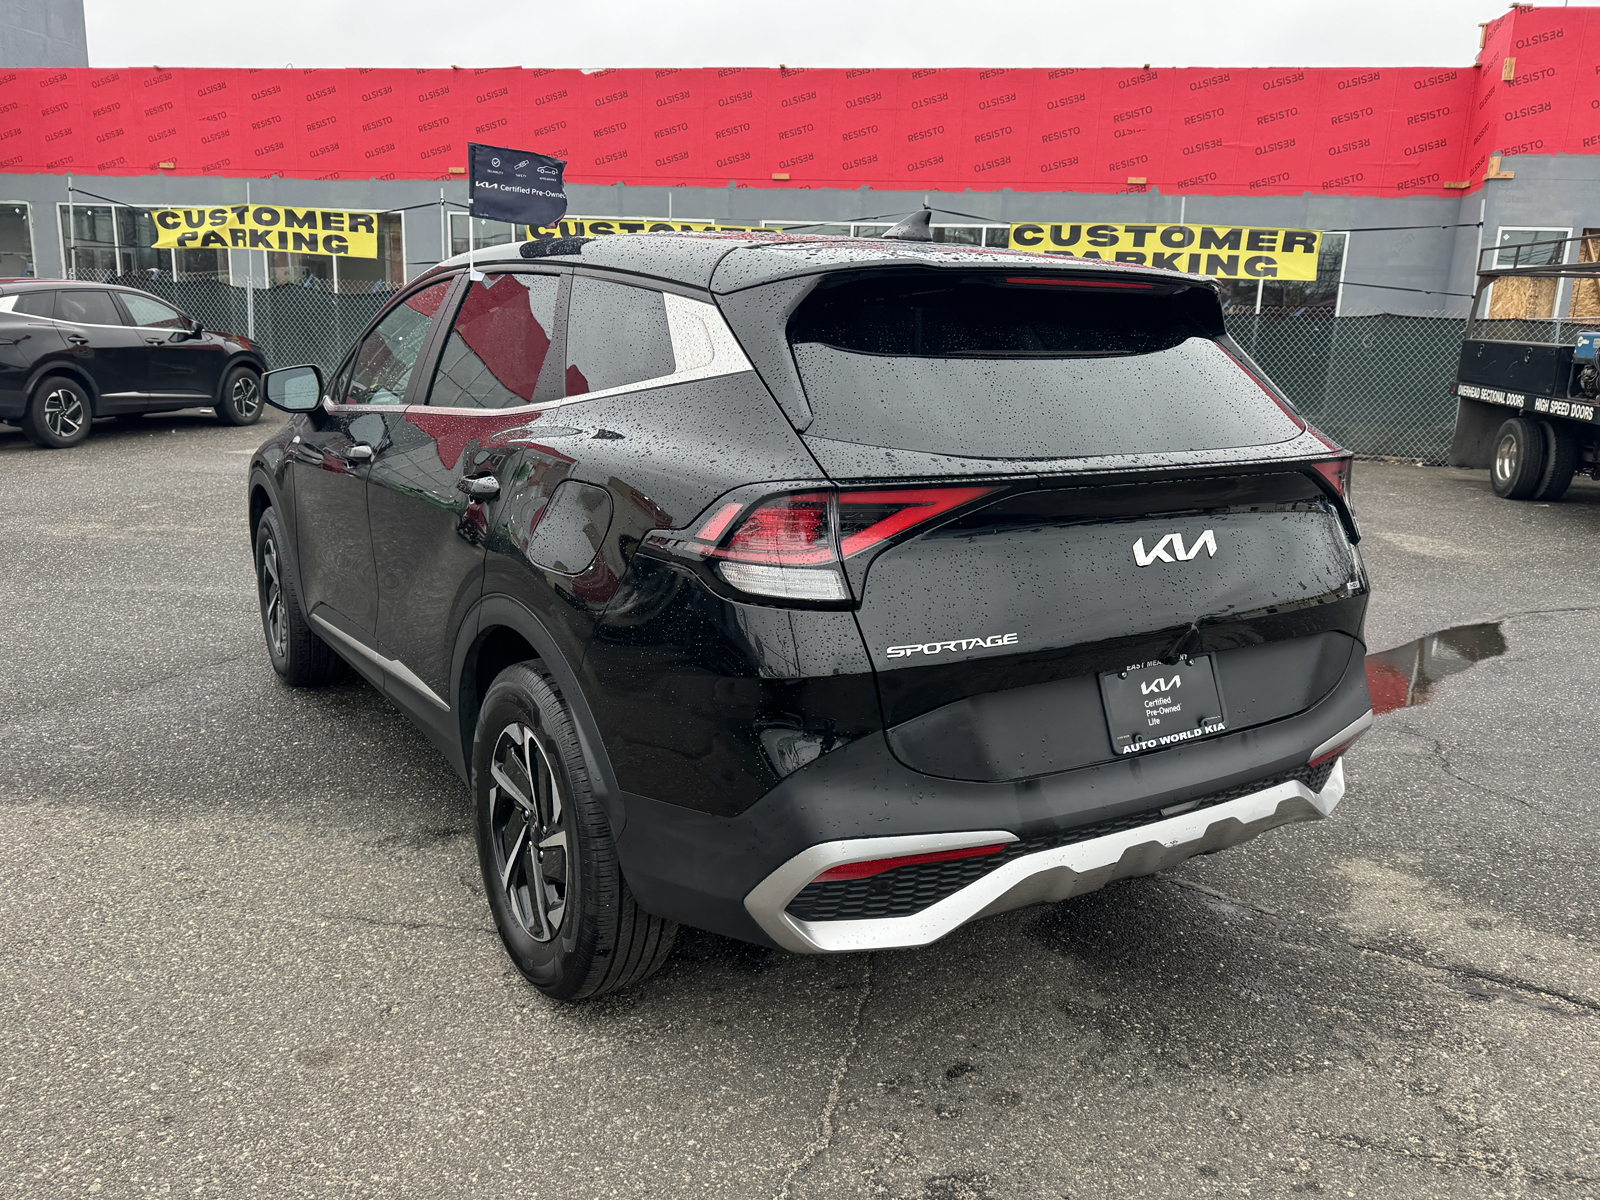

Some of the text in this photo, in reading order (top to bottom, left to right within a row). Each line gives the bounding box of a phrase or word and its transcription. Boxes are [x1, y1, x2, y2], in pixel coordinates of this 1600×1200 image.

[1516, 28, 1564, 49] RESISTO
[40, 74, 67, 87] RESISTO
[92, 73, 119, 88] RESISTO
[144, 73, 172, 87] RESISTO
[1118, 71, 1159, 89] RESISTO
[1189, 73, 1231, 91] RESISTO
[1262, 73, 1305, 91] RESISTO
[1338, 72, 1380, 90] RESISTO
[1413, 71, 1457, 90] RESISTO
[198, 82, 226, 97] RESISTO
[252, 86, 281, 100] RESISTO
[306, 86, 336, 102] RESISTO
[362, 86, 392, 102] RESISTO
[419, 86, 450, 102] RESISTO
[476, 88, 508, 103] RESISTO
[535, 90, 568, 106] RESISTO
[595, 91, 628, 106] RESISTO
[656, 91, 690, 107] RESISTO
[718, 90, 752, 107] RESISTO
[782, 91, 816, 108] RESISTO
[846, 92, 882, 108] RESISTO
[912, 92, 948, 110] RESISTO
[979, 93, 1016, 110] RESISTO
[1047, 93, 1086, 110] RESISTO
[42, 102, 68, 116] RESISTO
[93, 102, 120, 117] RESISTO
[145, 102, 173, 116] RESISTO
[1114, 106, 1154, 123] RESISTO
[1184, 108, 1224, 125] RESISTO
[1257, 108, 1298, 125] RESISTO
[1332, 107, 1373, 125] RESISTO
[1407, 107, 1450, 125] RESISTO
[1503, 102, 1552, 122] RESISTO
[252, 116, 281, 130] RESISTO
[307, 116, 336, 132] RESISTO
[362, 116, 392, 132] RESISTO
[418, 117, 449, 132] RESISTO
[476, 118, 507, 134] RESISTO
[534, 121, 566, 137] RESISTO
[594, 122, 626, 138] RESISTO
[654, 123, 688, 139] RESISTO
[716, 123, 750, 139] RESISTO
[45, 128, 72, 142] RESISTO
[96, 128, 124, 142] RESISTO
[148, 128, 176, 142] RESISTO
[202, 130, 230, 144] RESISTO
[779, 124, 814, 140] RESISTO
[842, 125, 878, 141] RESISTO
[908, 126, 944, 142] RESISTO
[975, 126, 1012, 143] RESISTO
[1042, 127, 1080, 143] RESISTO
[255, 142, 284, 156] RESISTO
[310, 143, 339, 158] RESISTO
[365, 144, 395, 158] RESISTO
[420, 144, 451, 160] RESISTO
[1183, 138, 1222, 156] RESISTO
[1255, 138, 1296, 156] RESISTO
[1329, 138, 1370, 156] RESISTO
[1404, 138, 1447, 156] RESISTO
[46, 156, 73, 171] RESISTO
[98, 157, 126, 170] RESISTO
[202, 158, 230, 172] RESISTO
[595, 150, 628, 166] RESISTO
[656, 151, 689, 167] RESISTO
[716, 152, 750, 168] RESISTO
[779, 153, 814, 170] RESISTO
[842, 154, 878, 170] RESISTO
[908, 155, 944, 172] RESISTO
[974, 156, 1011, 172] RESISTO
[1041, 156, 1078, 172] RESISTO
[1109, 155, 1148, 172] RESISTO
[1177, 172, 1218, 189] RESISTO
[1249, 172, 1290, 189] RESISTO
[1322, 173, 1364, 190] RESISTO
[1397, 173, 1440, 190] RESISTO
[500, 184, 530, 194] Certified
[157, 206, 375, 233] CUSTOMER
[177, 228, 349, 254] PARKING
[1013, 224, 1318, 253] CUSTOMER
[1458, 385, 1525, 407] OVERHEAD SECTIONAL DOORS
[1535, 398, 1594, 420] HIGH SPEED DOORS
[886, 633, 1018, 659] SPORTAGE
[1126, 662, 1145, 671] EAST
[1144, 696, 1171, 707] Certified
[1146, 704, 1181, 717] Pre-Owned
[1148, 718, 1160, 726] Life
[1122, 722, 1226, 754] AUTO WORLD KIA
